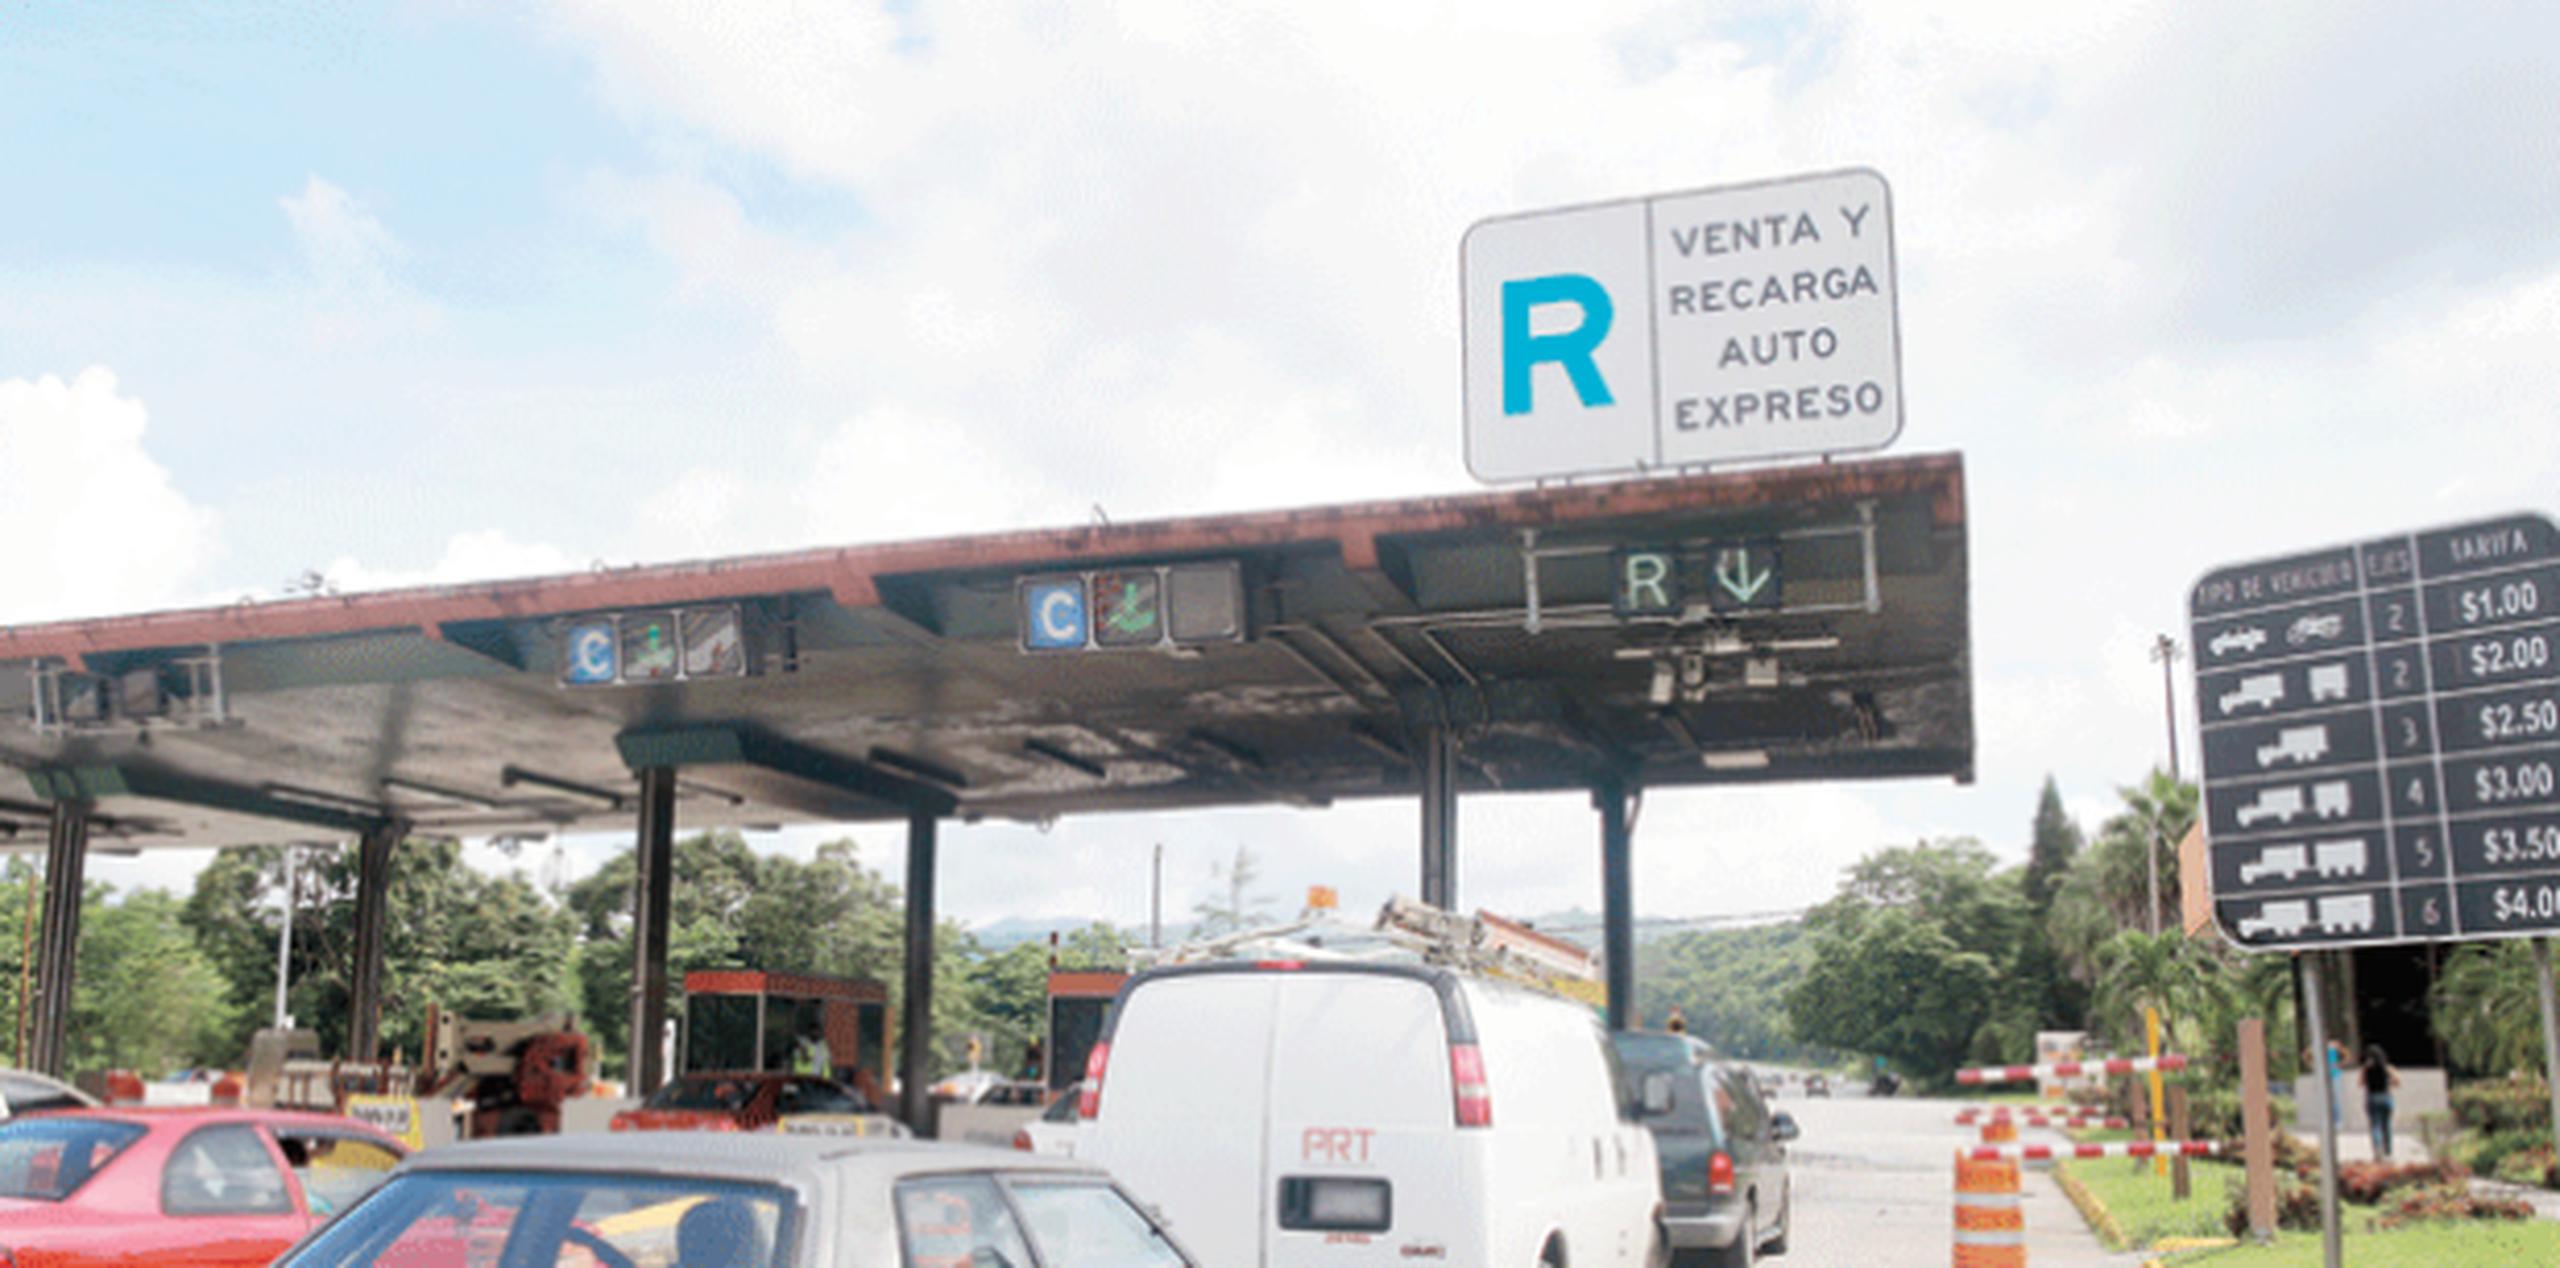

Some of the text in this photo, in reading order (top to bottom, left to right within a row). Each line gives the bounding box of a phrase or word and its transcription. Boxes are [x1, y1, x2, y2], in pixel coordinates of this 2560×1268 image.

[1672, 204, 1870, 257] VENTA Y
[1669, 265, 1878, 316] RECARGA
[1502, 273, 1615, 416] R
[1718, 326, 1838, 369] AUTO
[1674, 381, 1884, 432] EXPRESO
[1626, 553, 1669, 610] R
[2386, 580, 2538, 632] 2 $1.00
[1040, 590, 1077, 641] C
[578, 630, 610, 675] C
[2470, 635, 2549, 677] $2.00
[2401, 699, 2558, 748] 3 $2.50
[2407, 762, 2553, 807] 4 $3.00
[2416, 838, 2433, 867] 5
[2422, 897, 2440, 925] 6
[1301, 1126, 1377, 1162] PRT
